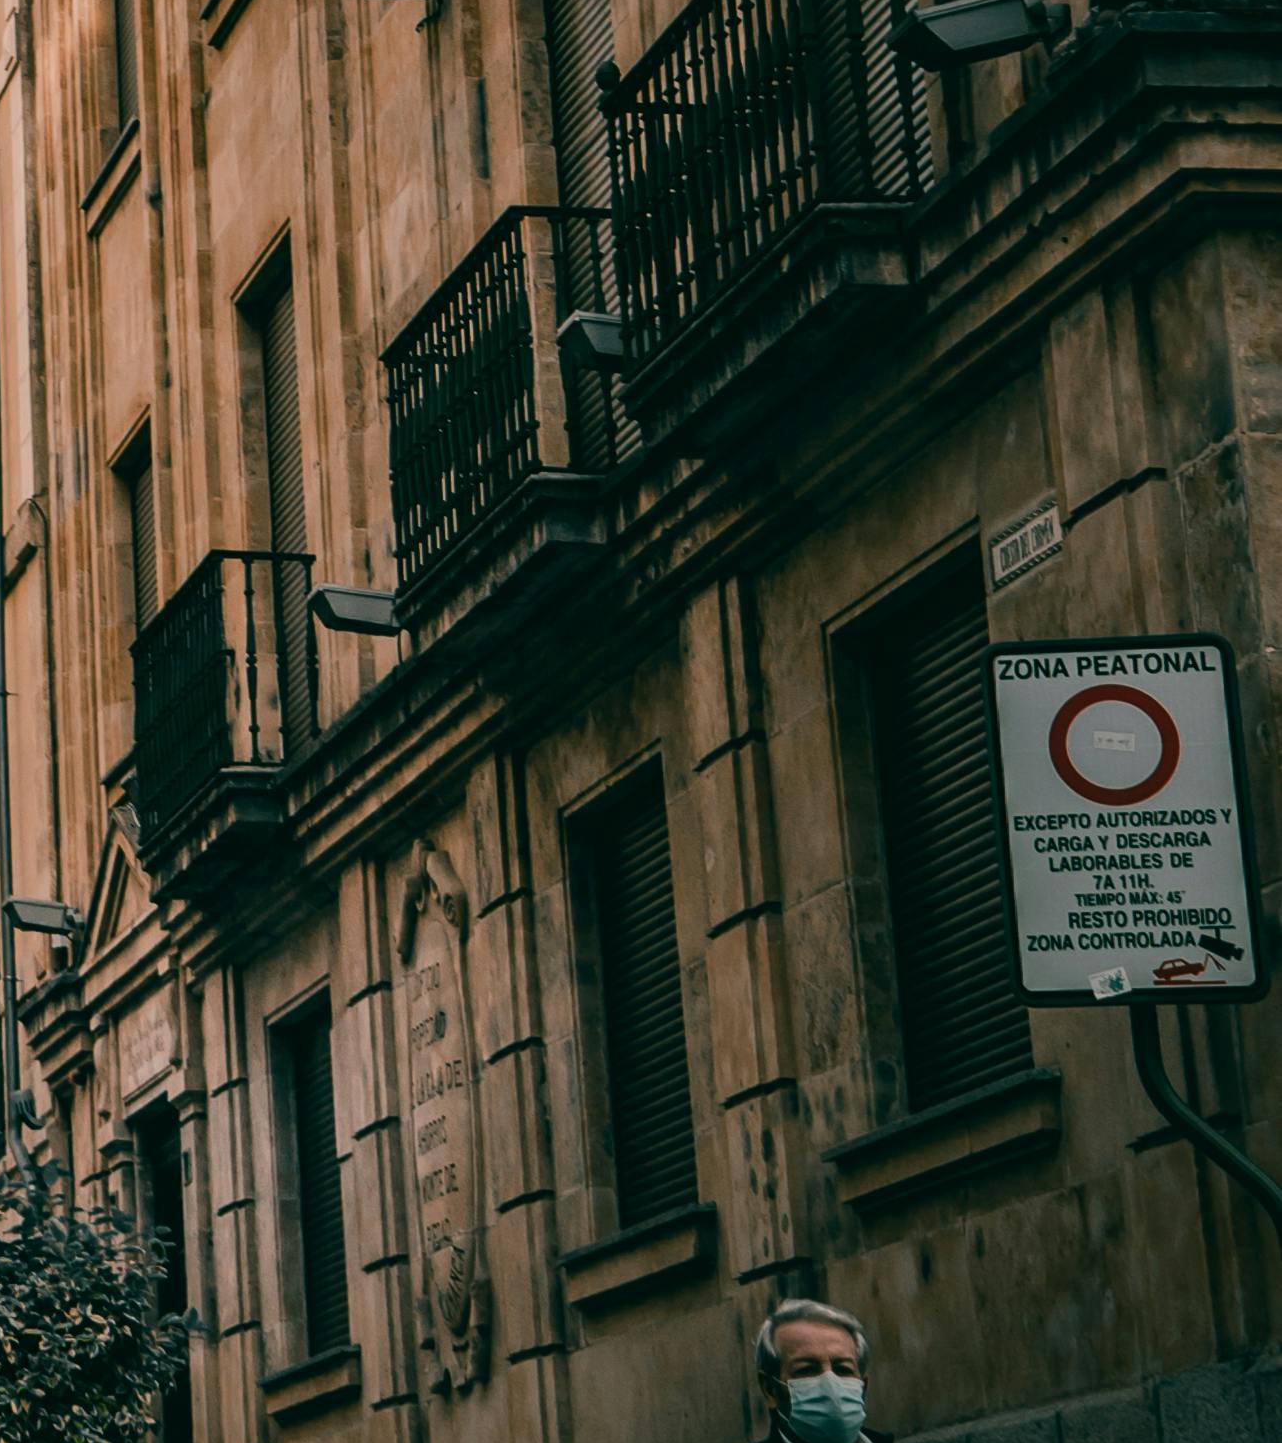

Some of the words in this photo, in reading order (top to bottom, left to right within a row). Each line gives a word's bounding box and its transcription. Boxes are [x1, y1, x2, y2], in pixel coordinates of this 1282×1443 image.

[997, 658, 1069, 680] ZONA
[1077, 651, 1216, 677] PEATONAL
[1014, 813, 1091, 831] EXCEPTO
[1096, 809, 1217, 828] AUTORIZADOS
[1220, 808, 1232, 824] Y
[1034, 835, 1094, 853] CARGA
[1098, 835, 1109, 850] Y
[1116, 831, 1212, 849] DESCARGA
[1048, 853, 1163, 872] LABORABLES
[1170, 852, 1194, 868] DE
[1093, 874, 1115, 890] 7A
[1120, 873, 1155, 889] 11H.
[1074, 893, 1126, 907] TIEMPO
[1129, 888, 1163, 905] MÁX:
[1068, 911, 1127, 929] RESTO
[1133, 908, 1232, 927] PROHIBIDO
[1026, 934, 1074, 952] ZONA
[1078, 931, 1196, 950] CONTROLADA
[445, 1059, 463, 1090] DE
